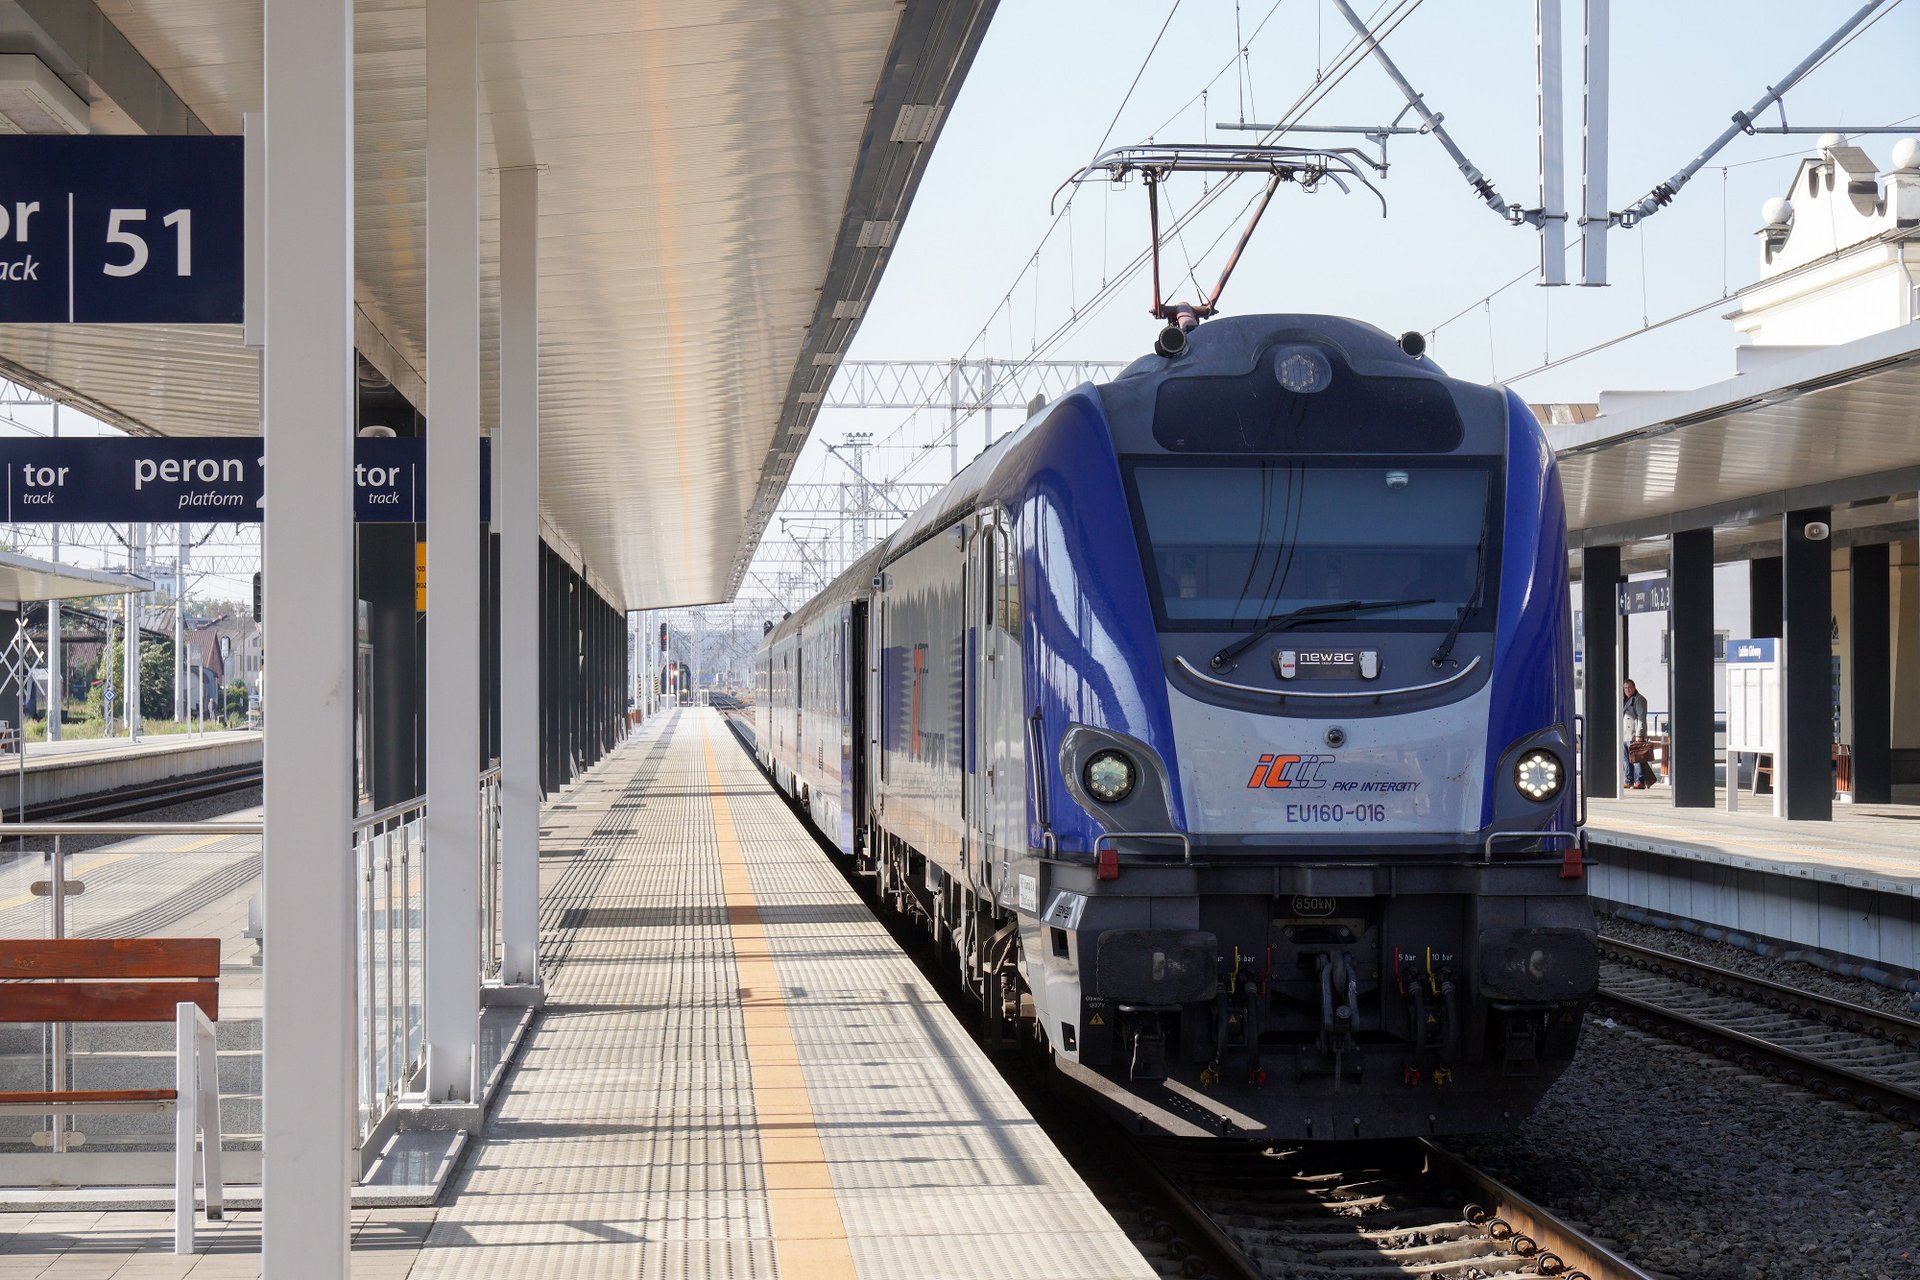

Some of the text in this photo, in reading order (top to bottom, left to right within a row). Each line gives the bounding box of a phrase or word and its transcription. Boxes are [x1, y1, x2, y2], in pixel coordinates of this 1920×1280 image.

[102, 208, 191, 278] 51
[23, 463, 69, 487] tor
[134, 458, 244, 491] peron
[354, 463, 400, 487] tor
[23, 491, 54, 504] track
[178, 491, 243, 509] platform
[368, 491, 400, 504] track
[1332, 782, 1422, 792] PKP INTERCITY
[1286, 804, 1386, 823] EU160-016
[1243, 954, 1256, 962] bar
[1404, 953, 1416, 961] bar
[1442, 953, 1453, 961] bar
